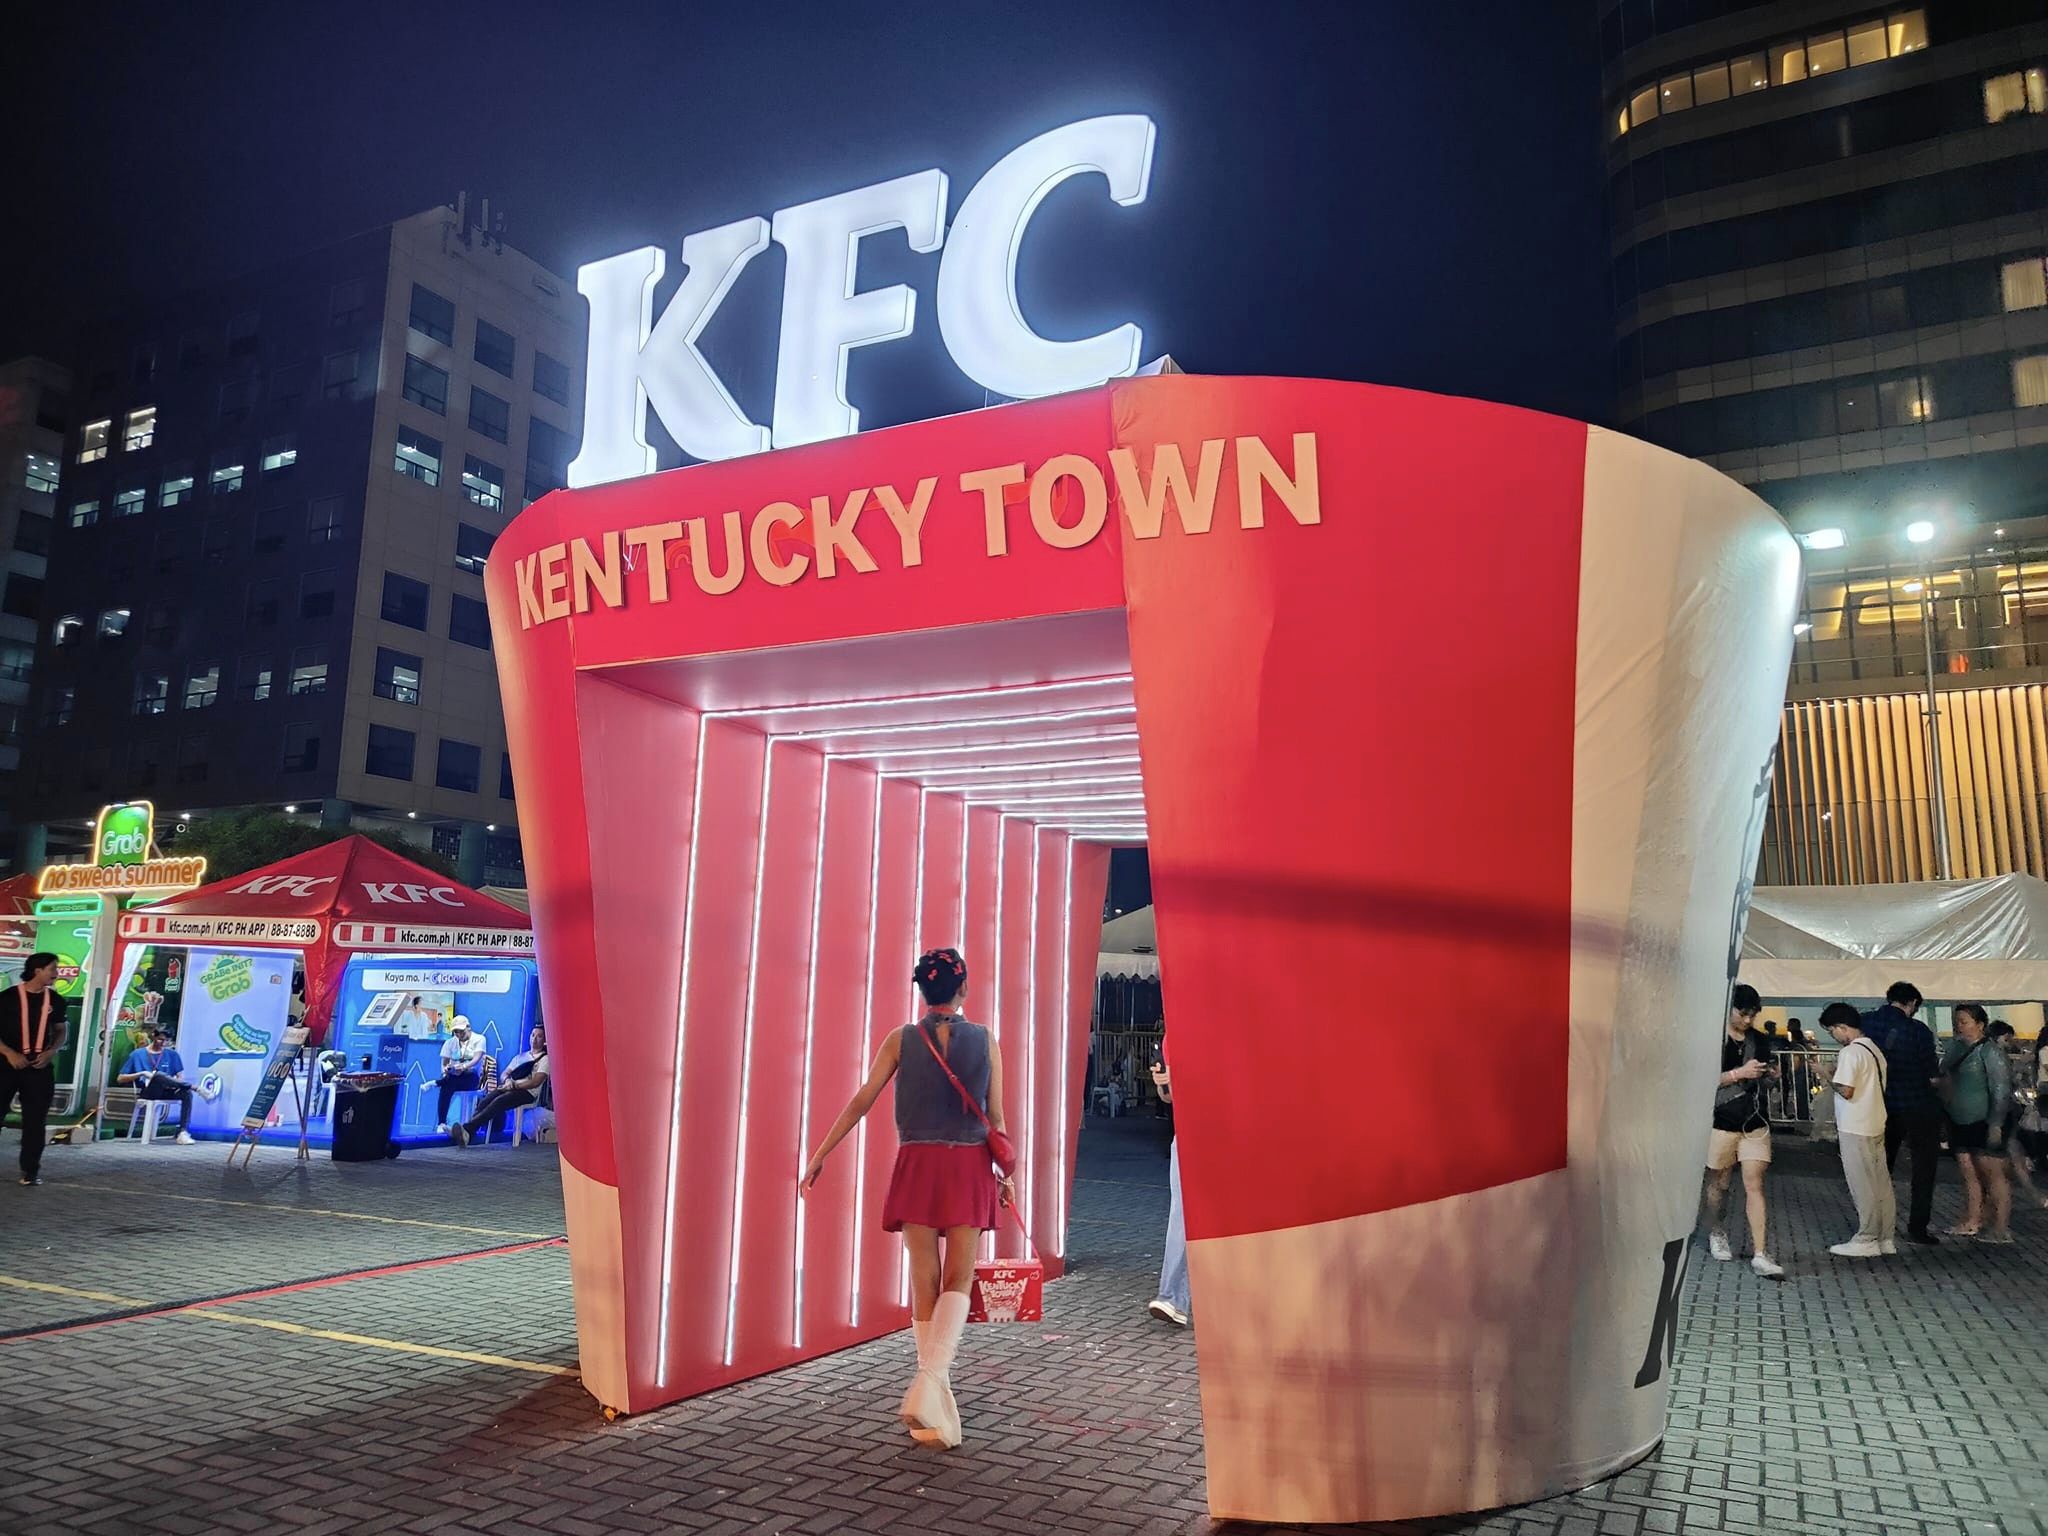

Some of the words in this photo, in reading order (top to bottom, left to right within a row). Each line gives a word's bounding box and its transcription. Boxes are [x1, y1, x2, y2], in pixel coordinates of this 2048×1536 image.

[567, 113, 1157, 487] KFC
[514, 477, 938, 631] KENTUCKY
[960, 432, 1322, 558] TOWN
[102, 827, 145, 855] Grab
[44, 867, 67, 889] no
[69, 864, 121, 888] sweat
[125, 861, 203, 886] summer
[225, 875, 337, 897] KFC
[361, 883, 465, 907] KFC
[169, 920, 211, 936] kfc.com.ph
[216, 922, 233, 935] KFC
[235, 922, 246, 935] PH
[249, 923, 265, 936] APP
[22, 941, 35, 950] kfc
[401, 931, 450, 947] kfc.com.ph
[457, 932, 475, 945] KFC
[477, 933, 489, 946] PH
[490, 934, 508, 947] APP
[513, 935, 534, 948] 88-87
[56, 967, 80, 976] KFC
[213, 977, 250, 1000] Grab
[993, 1270, 1016, 1279] KFC
